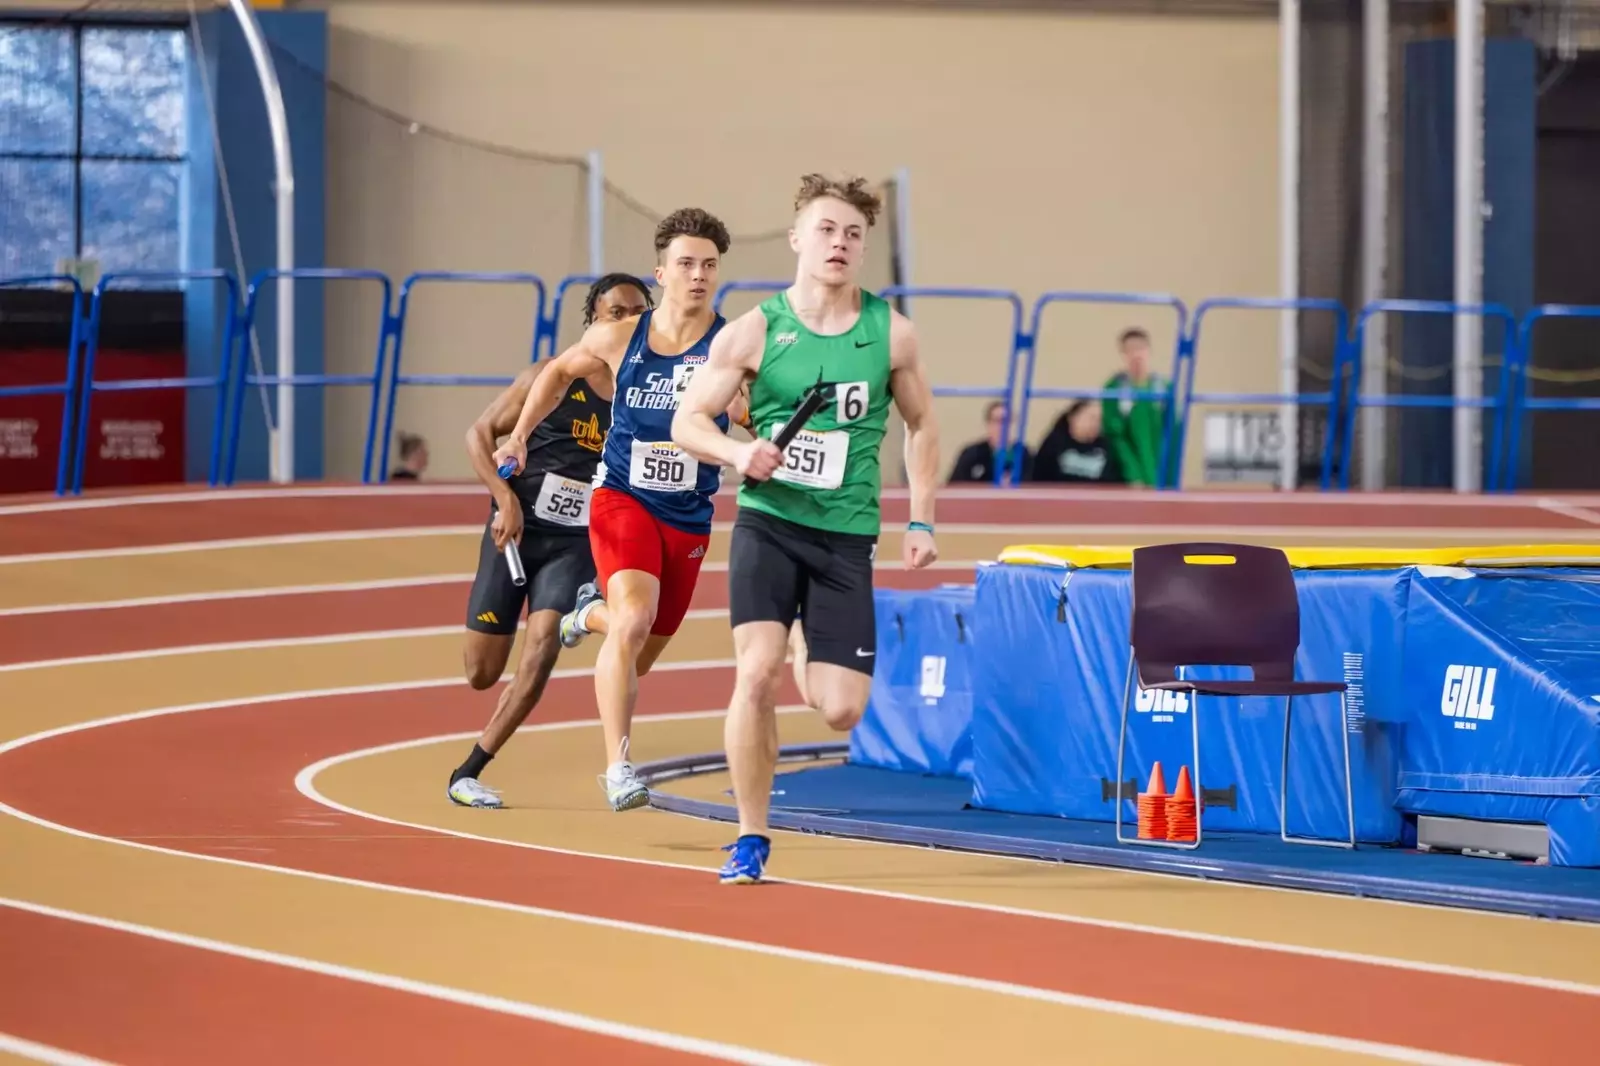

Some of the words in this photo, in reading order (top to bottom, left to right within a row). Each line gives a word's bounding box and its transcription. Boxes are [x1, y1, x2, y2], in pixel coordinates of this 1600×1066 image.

[626, 387, 680, 411] ALABA
[844, 385, 862, 420] 6
[642, 457, 685, 483] 580
[786, 445, 826, 475] 551
[547, 493, 585, 518] 525
[1441, 664, 1497, 721] GILL
